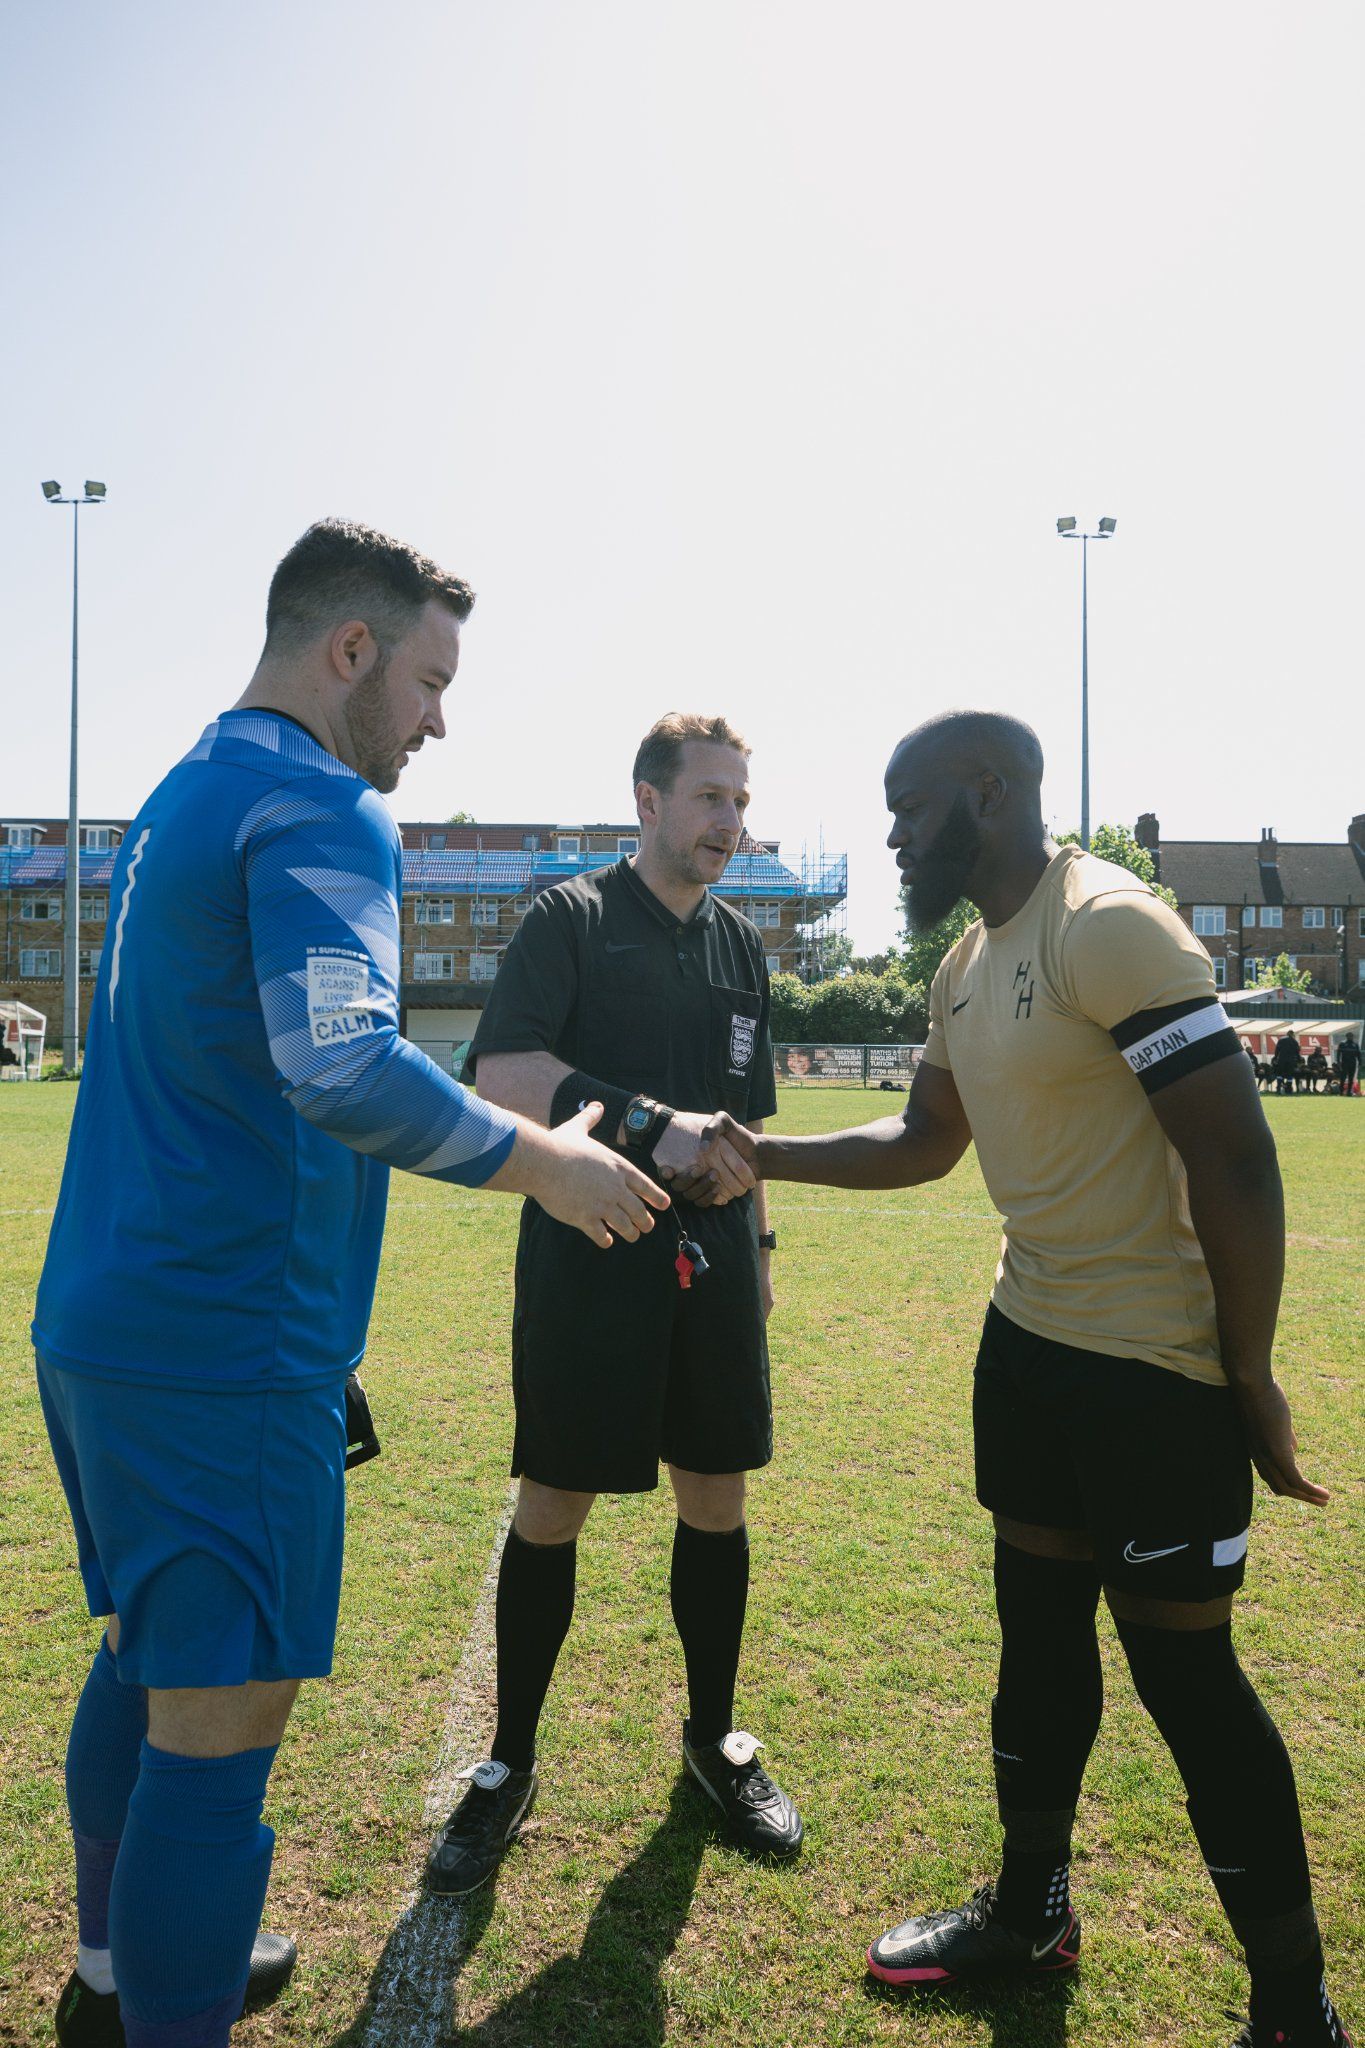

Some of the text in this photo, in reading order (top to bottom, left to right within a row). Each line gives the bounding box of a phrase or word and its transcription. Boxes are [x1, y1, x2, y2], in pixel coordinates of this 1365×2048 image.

[306, 947, 317, 955] IN
[318, 947, 358, 958] SUPPORT
[315, 1014, 370, 1041] CALM
[1129, 1028, 1189, 1070] CAPTAIN
